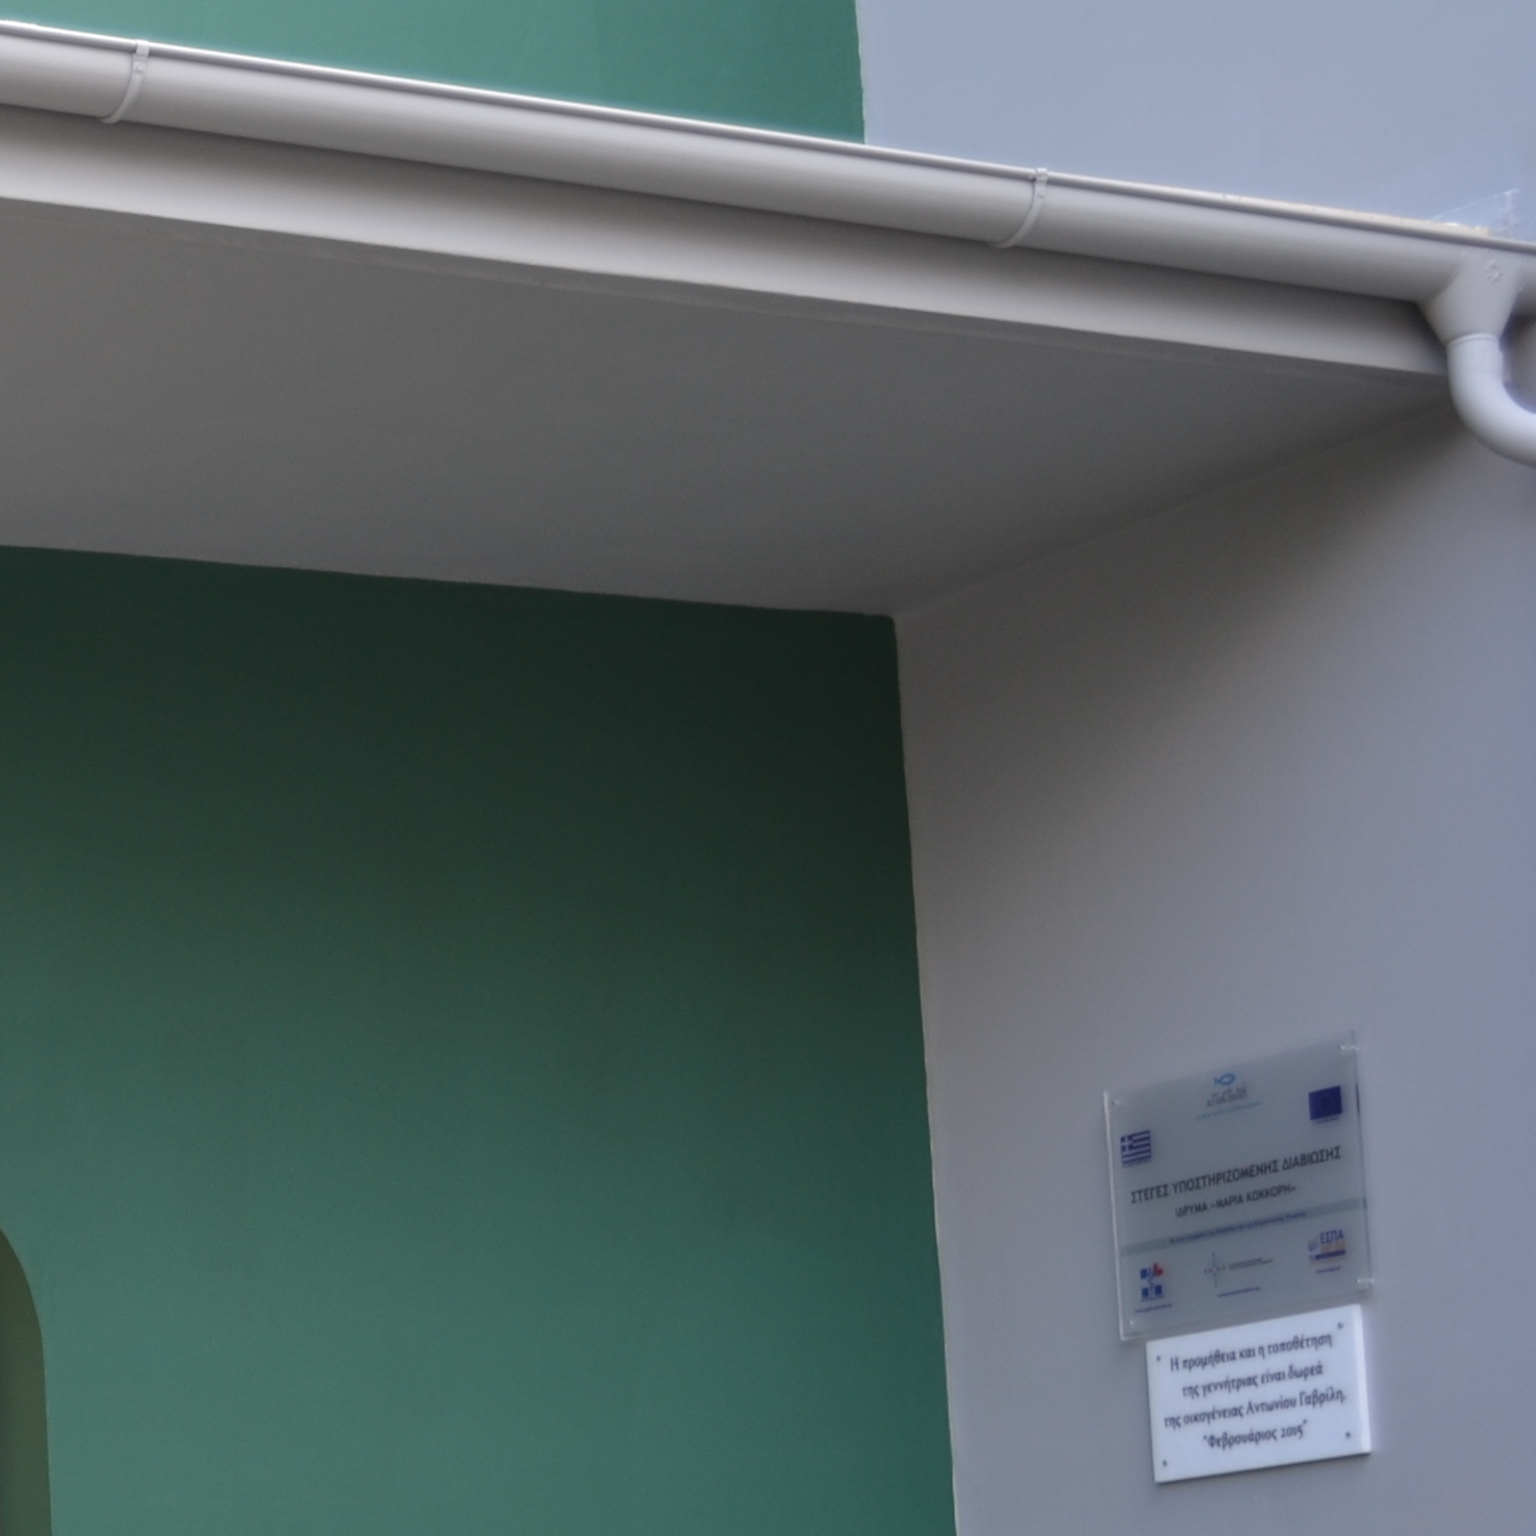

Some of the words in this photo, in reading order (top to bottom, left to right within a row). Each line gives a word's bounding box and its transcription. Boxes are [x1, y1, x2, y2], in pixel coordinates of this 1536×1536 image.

[1131, 1183, 1169, 1204] ΣΤΕΓΕΣ
[1172, 1159, 1279, 1195] ΥΠΟΣΤΗΡΙΖΟΜΕΝΗΣ
[1282, 1145, 1342, 1171] ΔΙΑΒΙΩΣΗΣ
[1170, 1356, 1180, 1372] Η
[1182, 1349, 1236, 1372] προμήθεια
[1238, 1347, 1256, 1360] και
[1258, 1345, 1265, 1359] η
[1267, 1333, 1332, 1355] τοποθέτηση
[1182, 1383, 1200, 1400] της
[1201, 1373, 1258, 1396] γεννήτριας
[1260, 1368, 1286, 1384] είναι
[1287, 1360, 1323, 1380] δωρεά
[1164, 1414, 1181, 1431] της
[1183, 1405, 1244, 1426] οικογένειας
[1246, 1394, 1297, 1415] Αντωνίου
